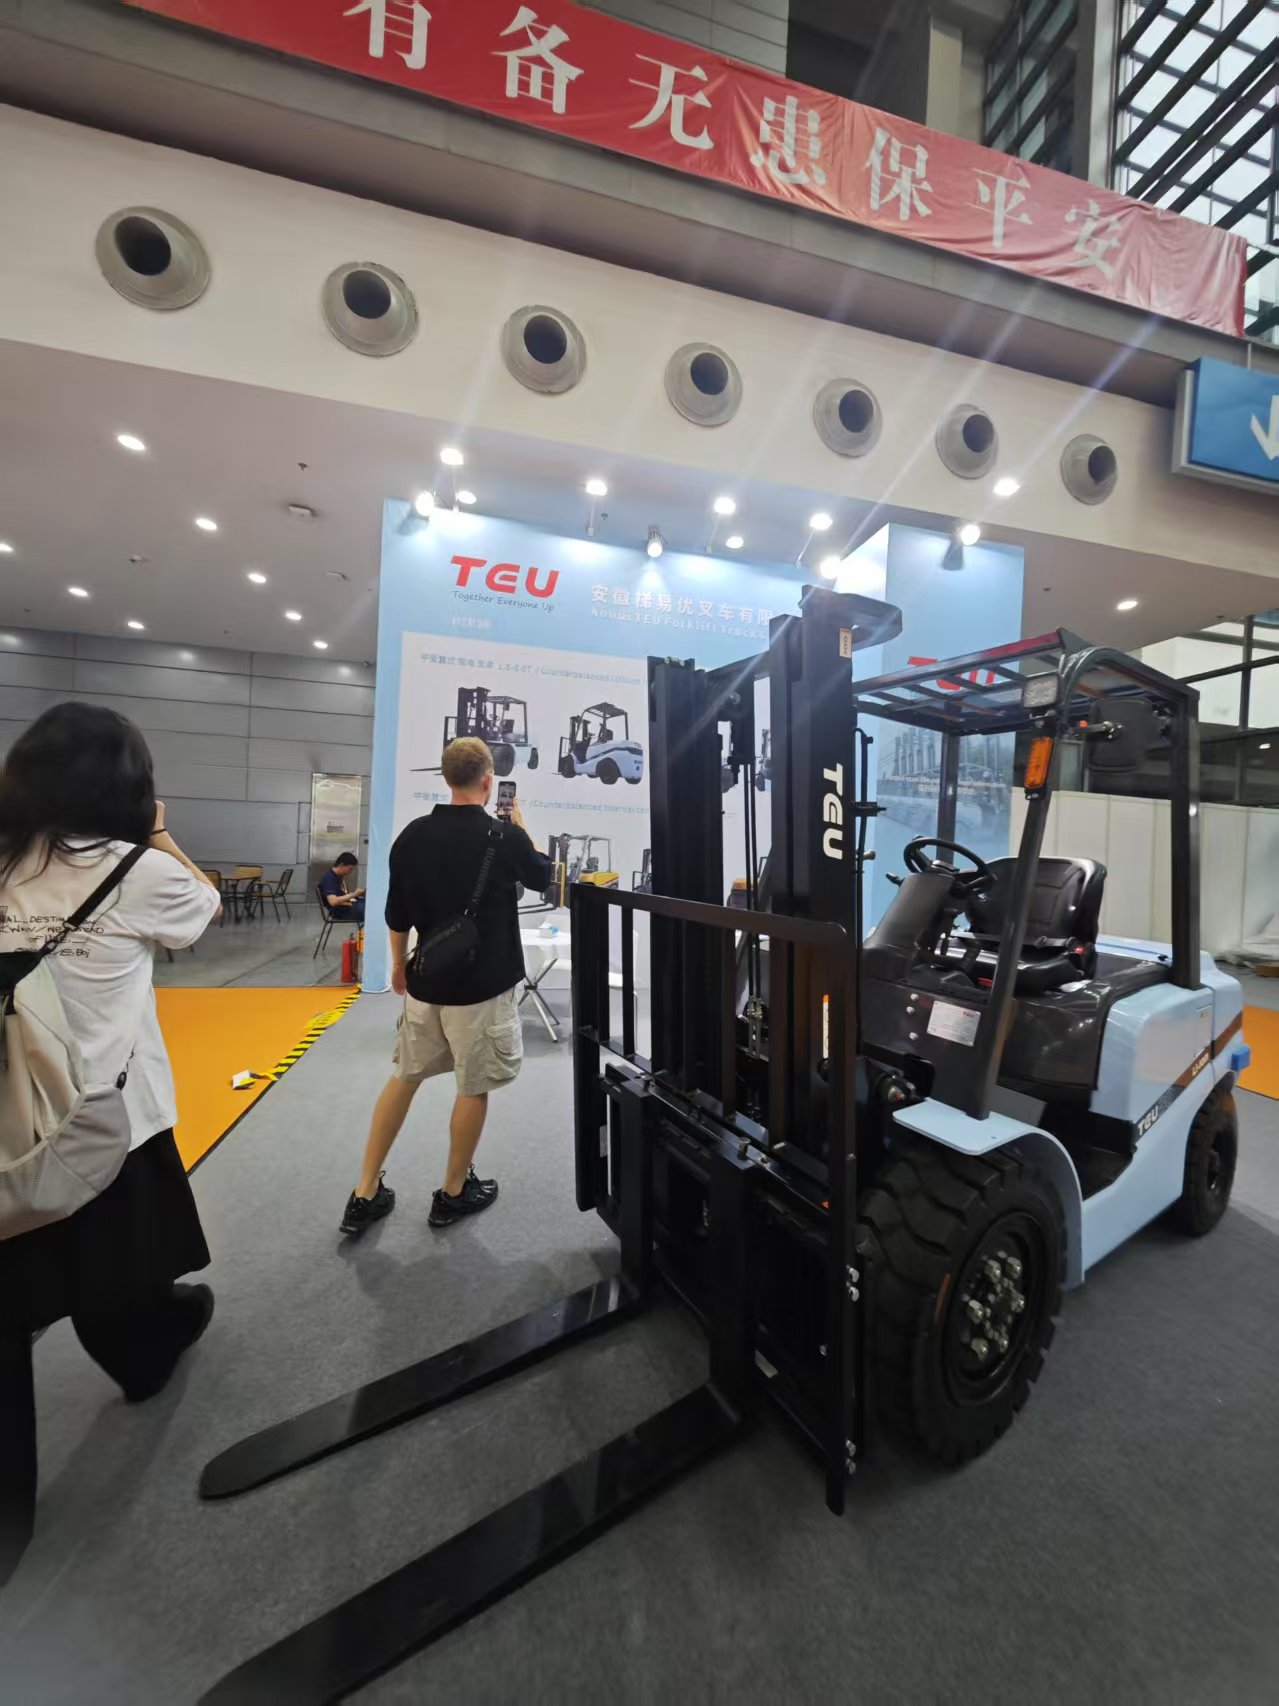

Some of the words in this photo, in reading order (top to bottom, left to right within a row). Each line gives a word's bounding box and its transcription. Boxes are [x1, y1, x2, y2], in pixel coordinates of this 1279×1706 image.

[343, 0, 1122, 280] 有备无患保平安
[450, 555, 560, 599] TEU
[451, 590, 494, 603] Together
[497, 596, 538, 609] Everyone
[541, 601, 555, 612] Up
[823, 762, 843, 860] TEU
[1137, 1104, 1159, 1136] TEU
